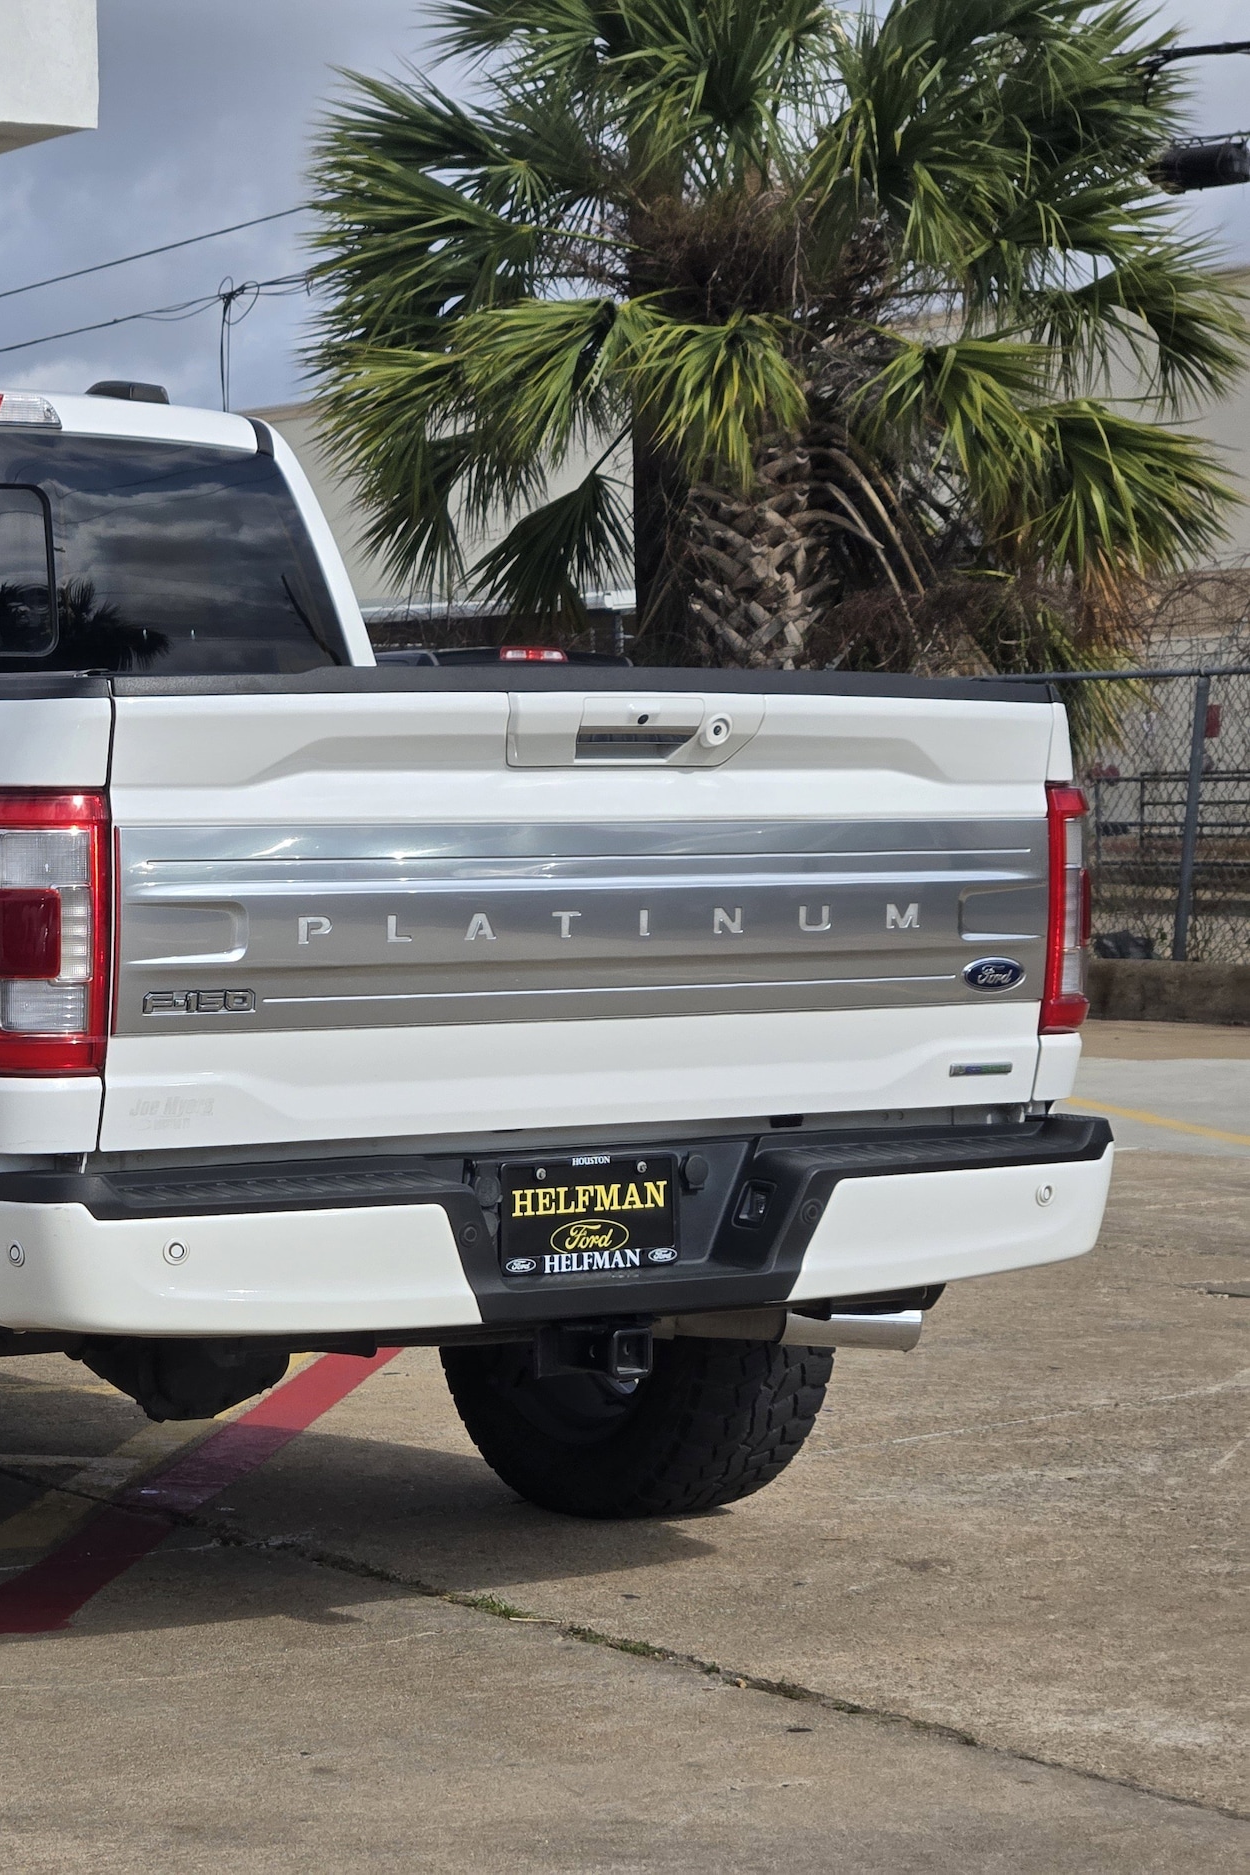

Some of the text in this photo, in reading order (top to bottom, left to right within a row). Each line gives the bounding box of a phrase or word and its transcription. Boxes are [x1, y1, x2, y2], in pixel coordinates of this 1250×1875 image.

[296, 903, 920, 945] PLATINUM
[977, 965, 1012, 984] Ford
[142, 988, 257, 1015] F-150
[572, 1156, 611, 1166] HOUSTON
[511, 1180, 668, 1217] HELFMAN
[564, 1224, 614, 1250] Ford
[543, 1248, 641, 1274] HELFMAN
